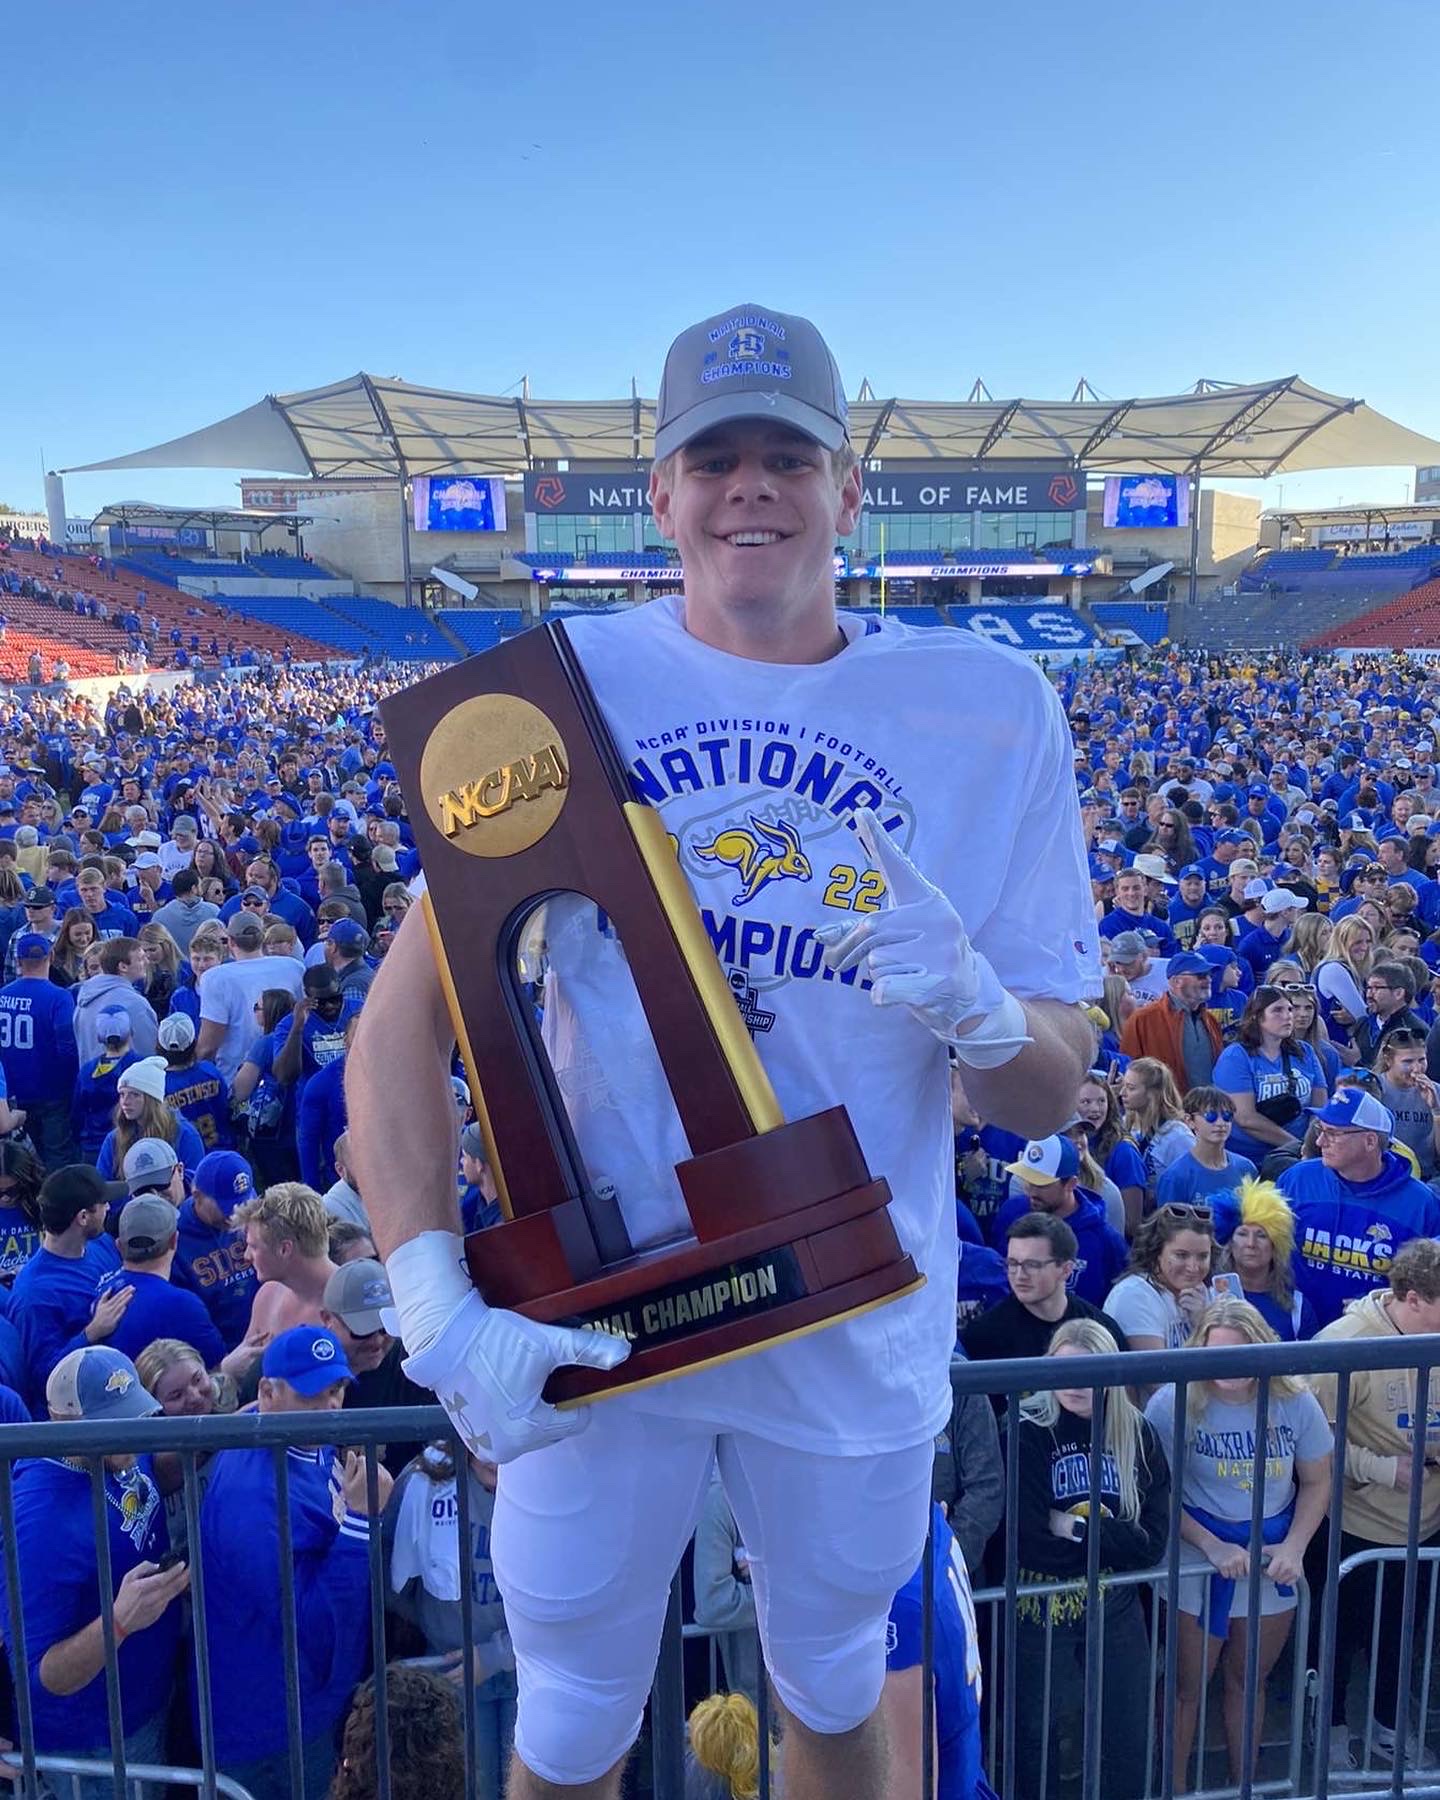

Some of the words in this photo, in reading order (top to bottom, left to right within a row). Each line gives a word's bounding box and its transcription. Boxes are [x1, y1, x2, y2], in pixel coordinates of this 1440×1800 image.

[709, 315, 786, 343] NATIONAL
[701, 361, 792, 385] CHAMPIONS
[589, 487, 655, 507] NATI
[919, 487, 950, 505] OF
[966, 486, 1028, 505] FAME
[931, 566, 1009, 576] CHAMPIONS
[636, 726, 688, 750] NCAA
[696, 719, 789, 735] DIVISION
[799, 727, 806, 739] I
[814, 731, 903, 798] FOOTBALL
[439, 745, 568, 839] NCAA
[822, 864, 887, 914] 22
[701, 908, 873, 991] MPIO
[0, 1011, 33, 1049] 30
[1302, 1227, 1393, 1271] JACKS
[1332, 1264, 1382, 1283] STATE
[642, 1265, 778, 1334] CHAMPION
[1217, 1460, 1284, 1479] NATON
